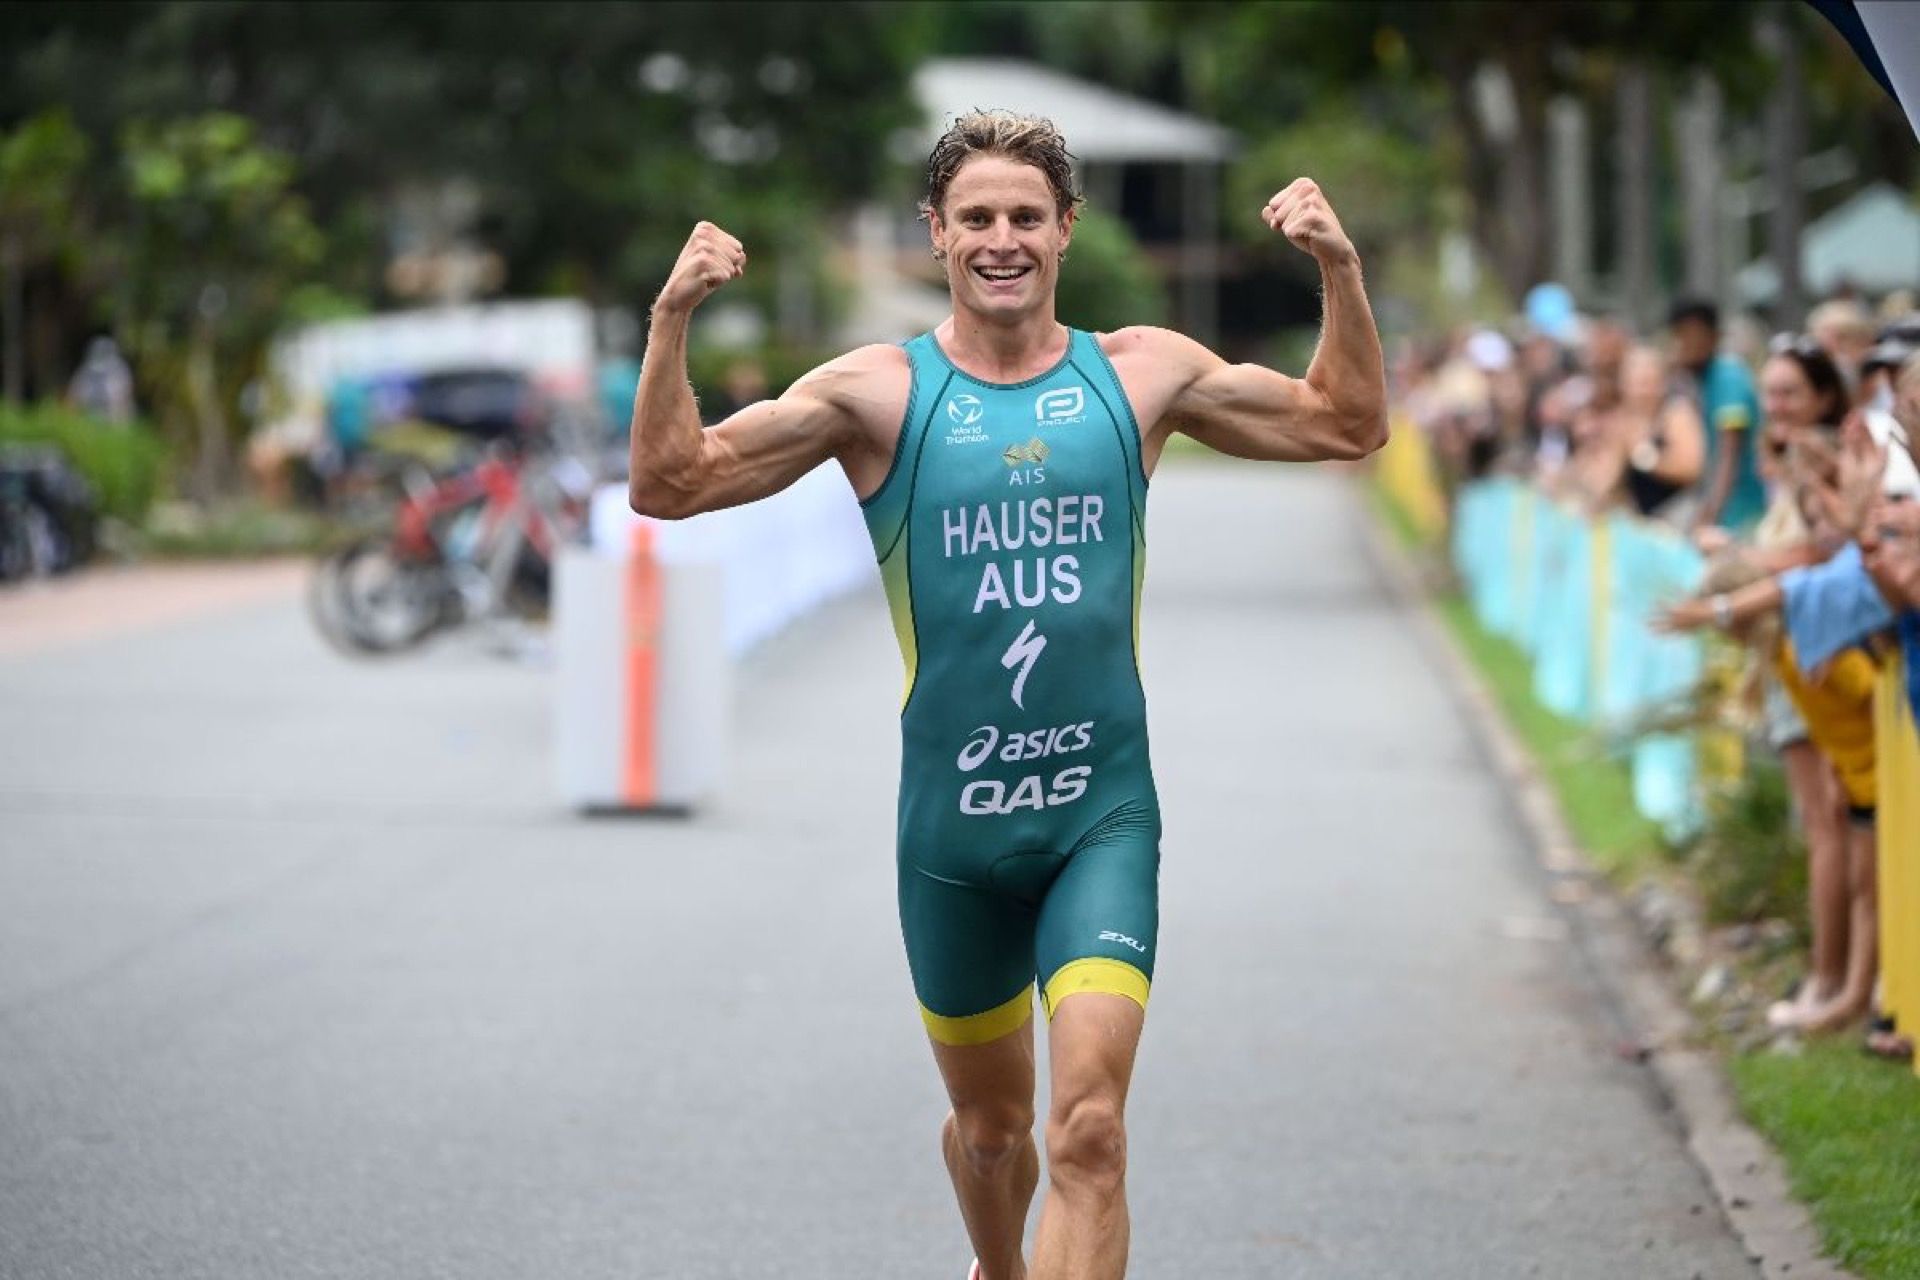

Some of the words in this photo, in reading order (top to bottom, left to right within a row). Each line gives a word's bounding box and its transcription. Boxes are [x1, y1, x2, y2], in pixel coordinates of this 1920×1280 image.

[951, 425, 982, 436] World
[1009, 466, 1046, 487] AIS
[943, 495, 1104, 558] HAUSER
[973, 554, 1082, 614] AUS
[960, 765, 1092, 815] QAS
